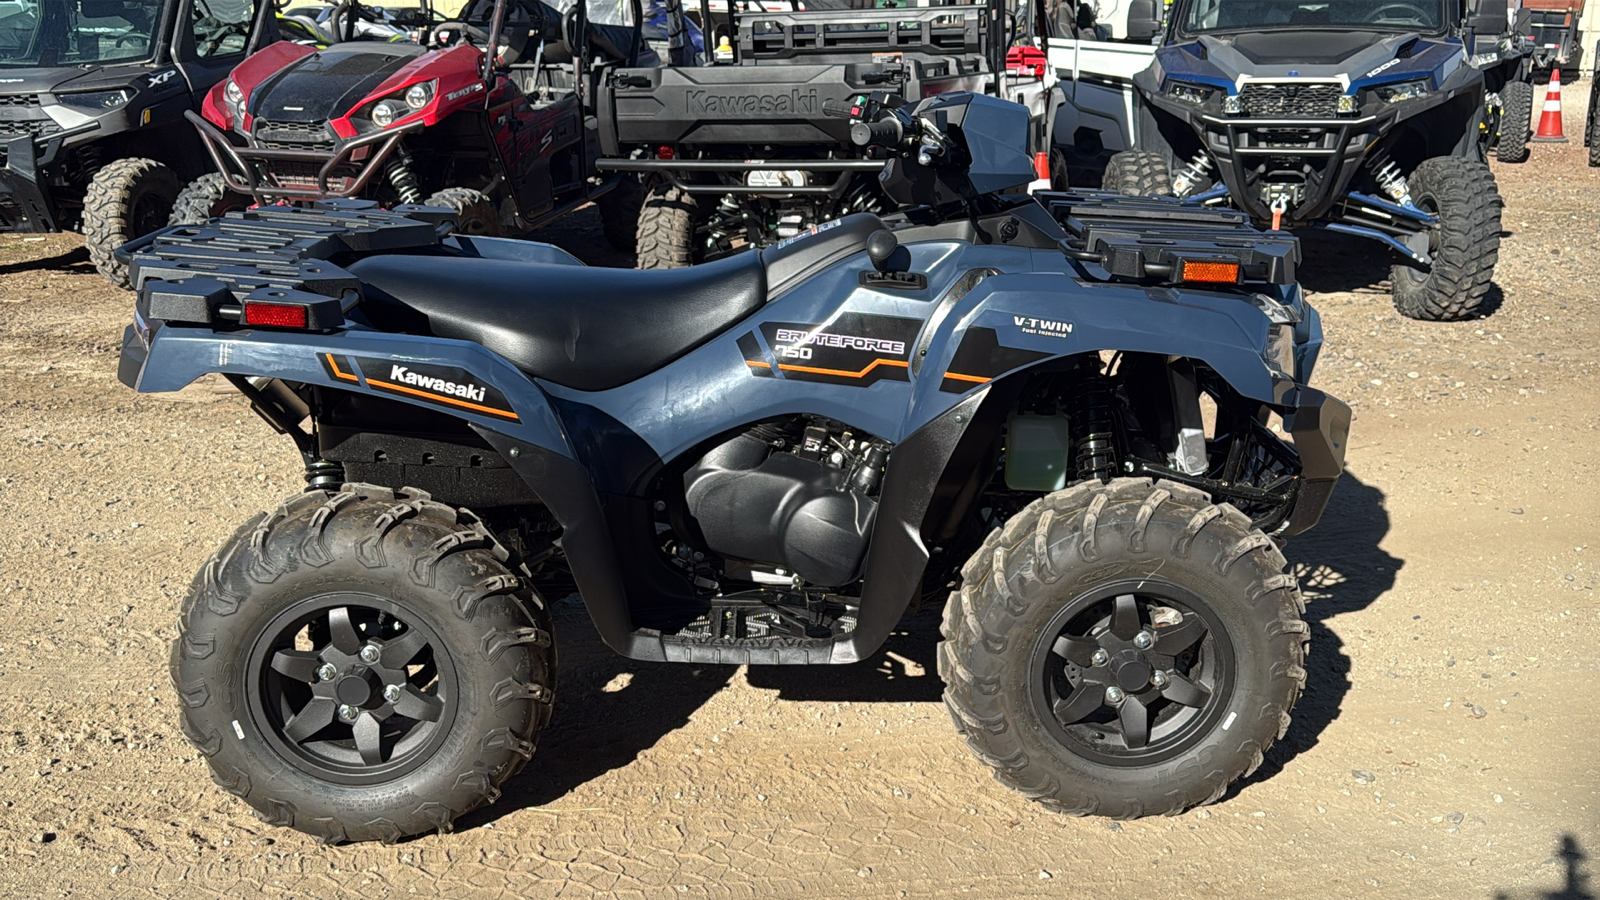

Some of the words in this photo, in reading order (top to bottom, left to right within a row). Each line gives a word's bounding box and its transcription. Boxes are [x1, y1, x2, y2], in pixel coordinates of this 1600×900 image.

[1366, 58, 1401, 78] 1000
[147, 69, 176, 89] XP
[685, 88, 817, 115] Kawasaki
[1013, 315, 1073, 333] V-TWIN
[1038, 329, 1067, 339] Injected
[774, 344, 813, 360] 750
[390, 364, 486, 402] Kawasaki
